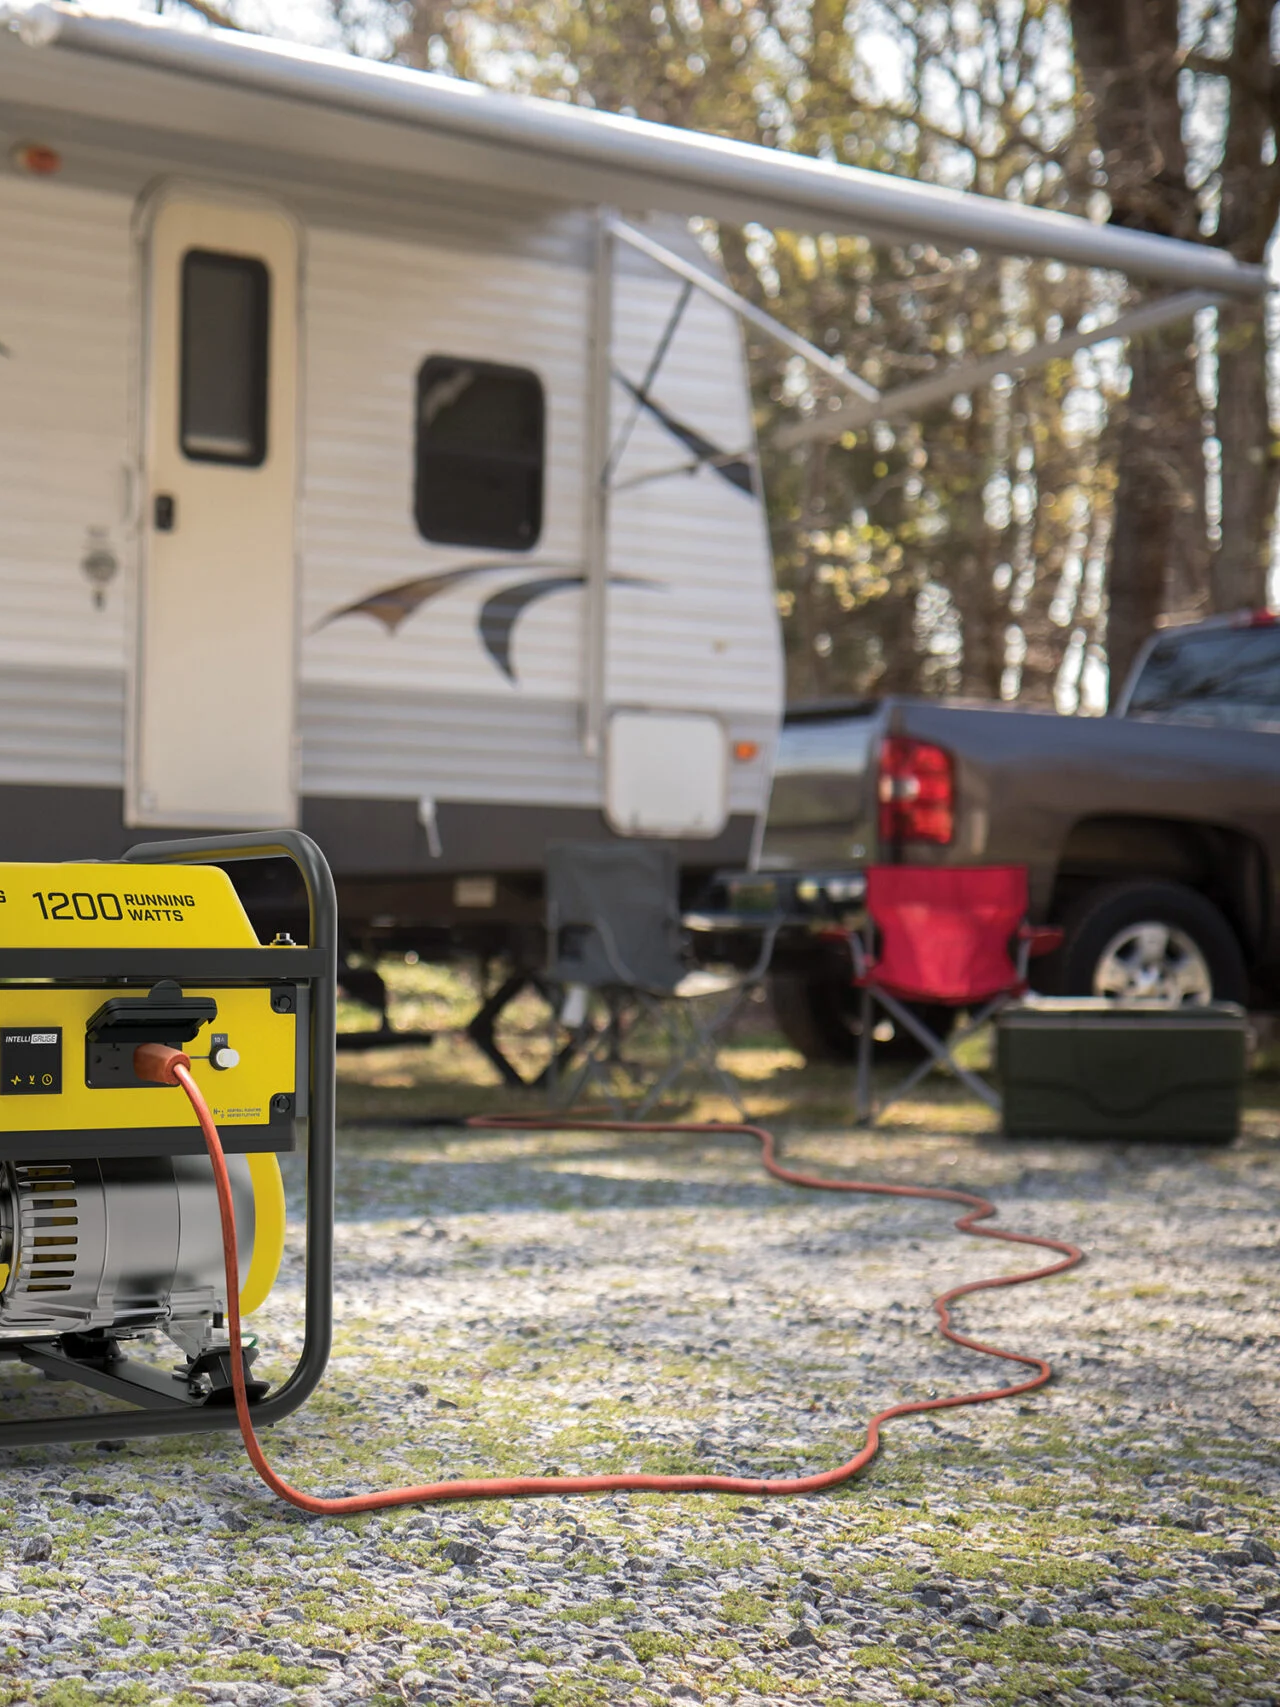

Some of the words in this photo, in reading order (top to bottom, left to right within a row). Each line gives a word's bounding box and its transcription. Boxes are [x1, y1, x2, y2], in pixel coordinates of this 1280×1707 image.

[32, 892, 124, 921] 1200
[123, 893, 196, 907] RUNNING
[128, 909, 184, 922] WATTS
